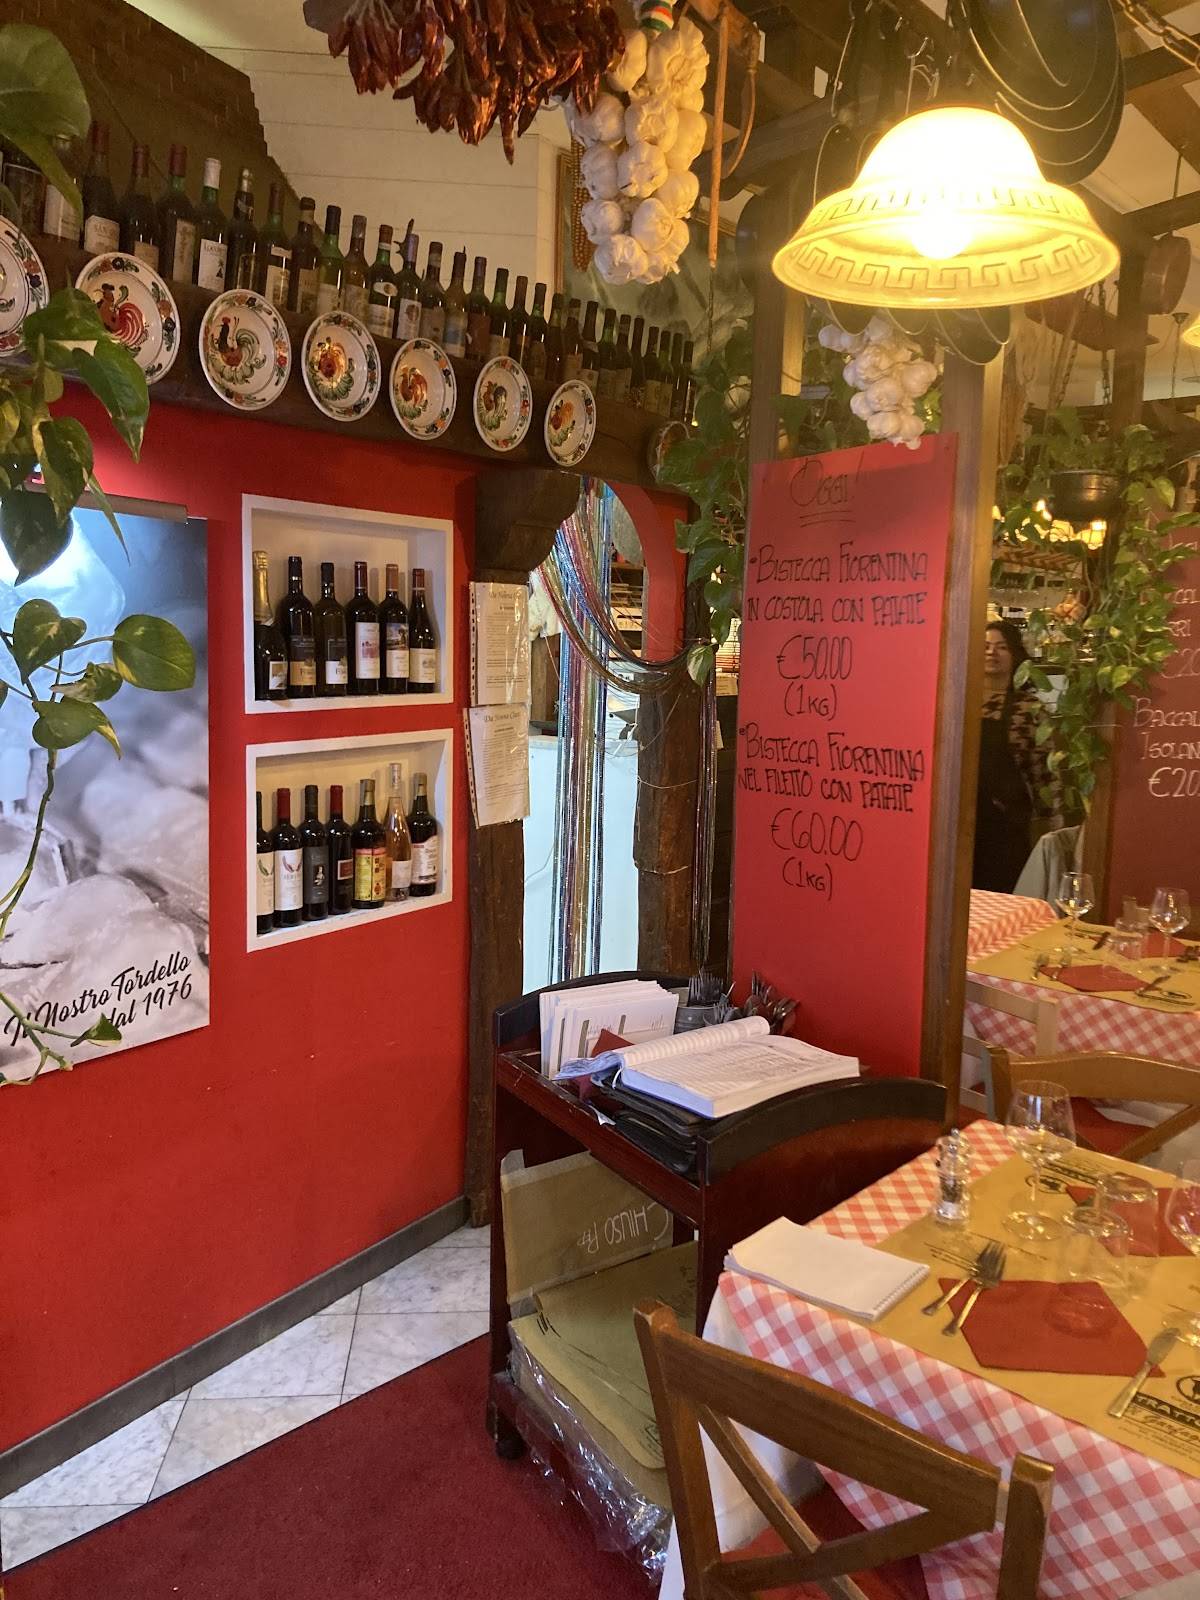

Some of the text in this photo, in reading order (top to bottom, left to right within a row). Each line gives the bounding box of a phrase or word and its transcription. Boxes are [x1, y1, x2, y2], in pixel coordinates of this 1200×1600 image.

[757, 541, 928, 583] BISTECCA FIORENTINA
[747, 592, 927, 626] IN COSTOLA CON PATATE
[746, 722, 925, 781] BISTECCA FIORENTINA
[738, 768, 913, 812] NEL FILETTO CON PATATE
[34, 988, 112, 1033] Nostro
[111, 951, 191, 1001] Tordello
[142, 973, 192, 1016] 1976
